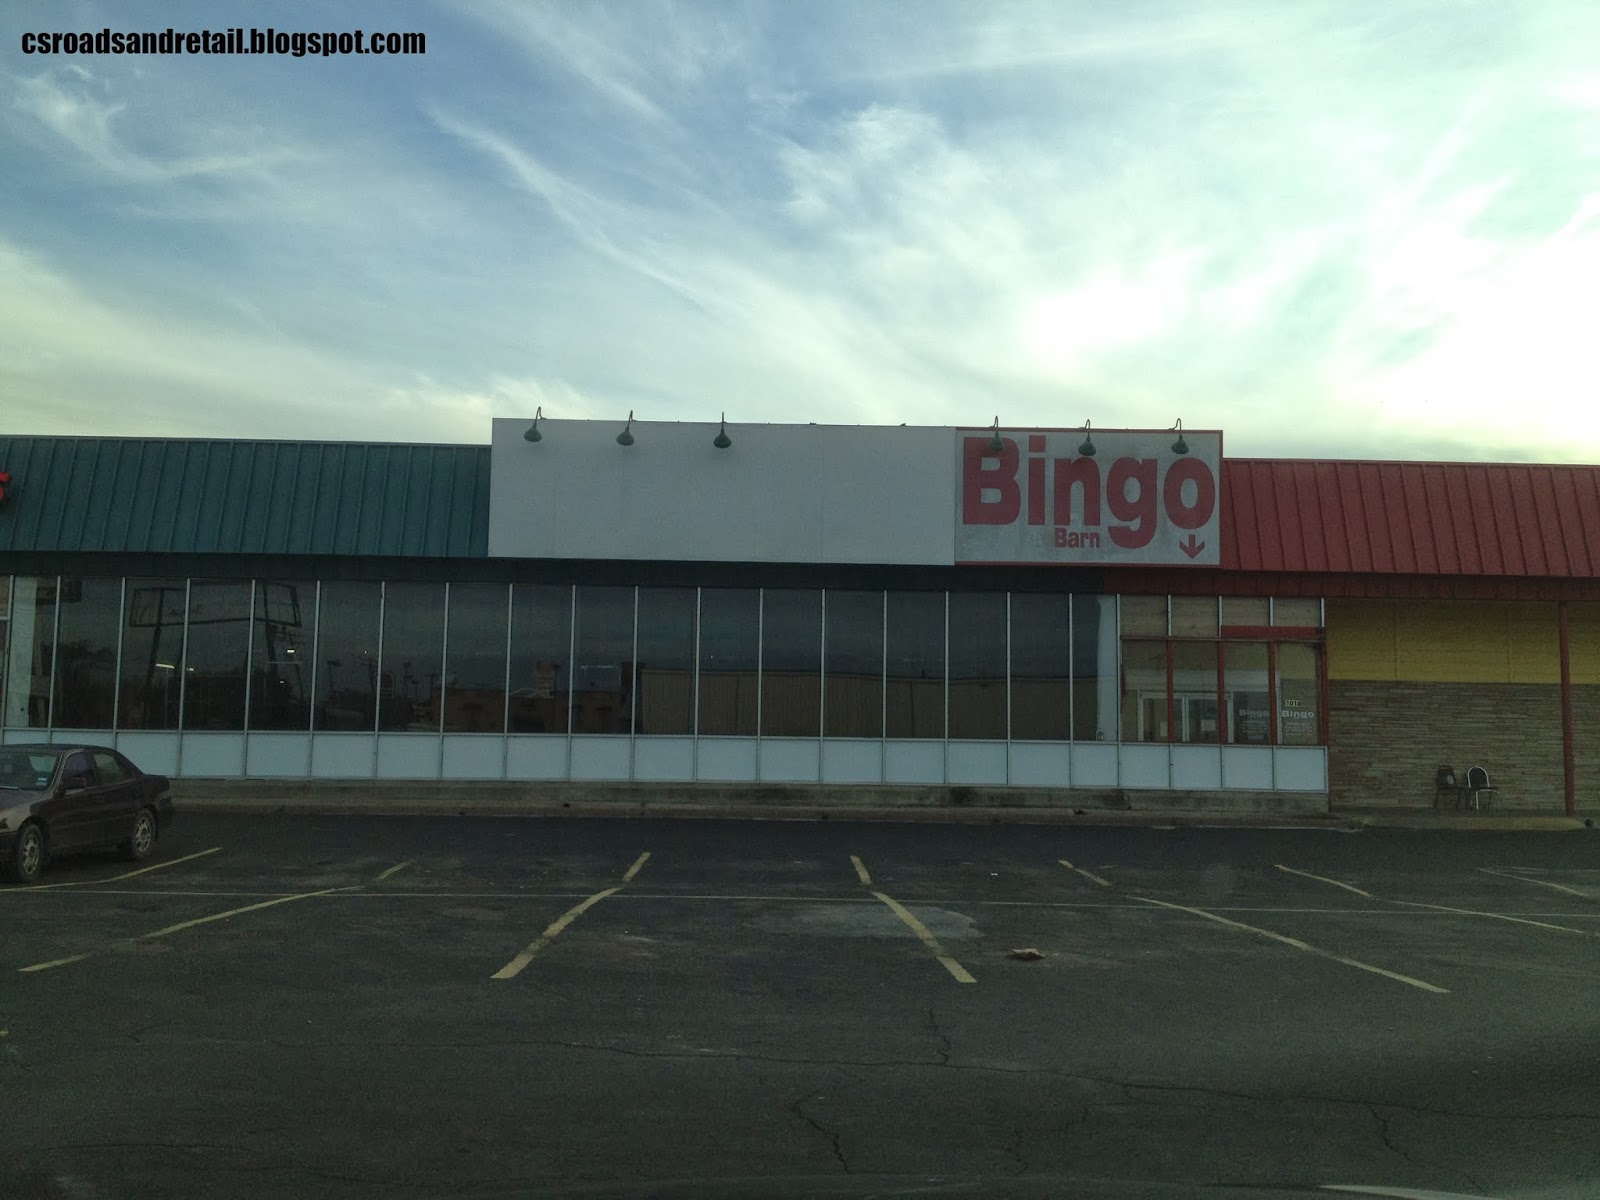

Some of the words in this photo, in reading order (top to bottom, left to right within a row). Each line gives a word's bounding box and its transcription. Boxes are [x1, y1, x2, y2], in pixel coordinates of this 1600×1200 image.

[963, 435, 1216, 549] Bingo
[1054, 527, 1100, 548] Barn
[1238, 709, 1270, 718] Bingo
[1281, 710, 1315, 719] Bingo
